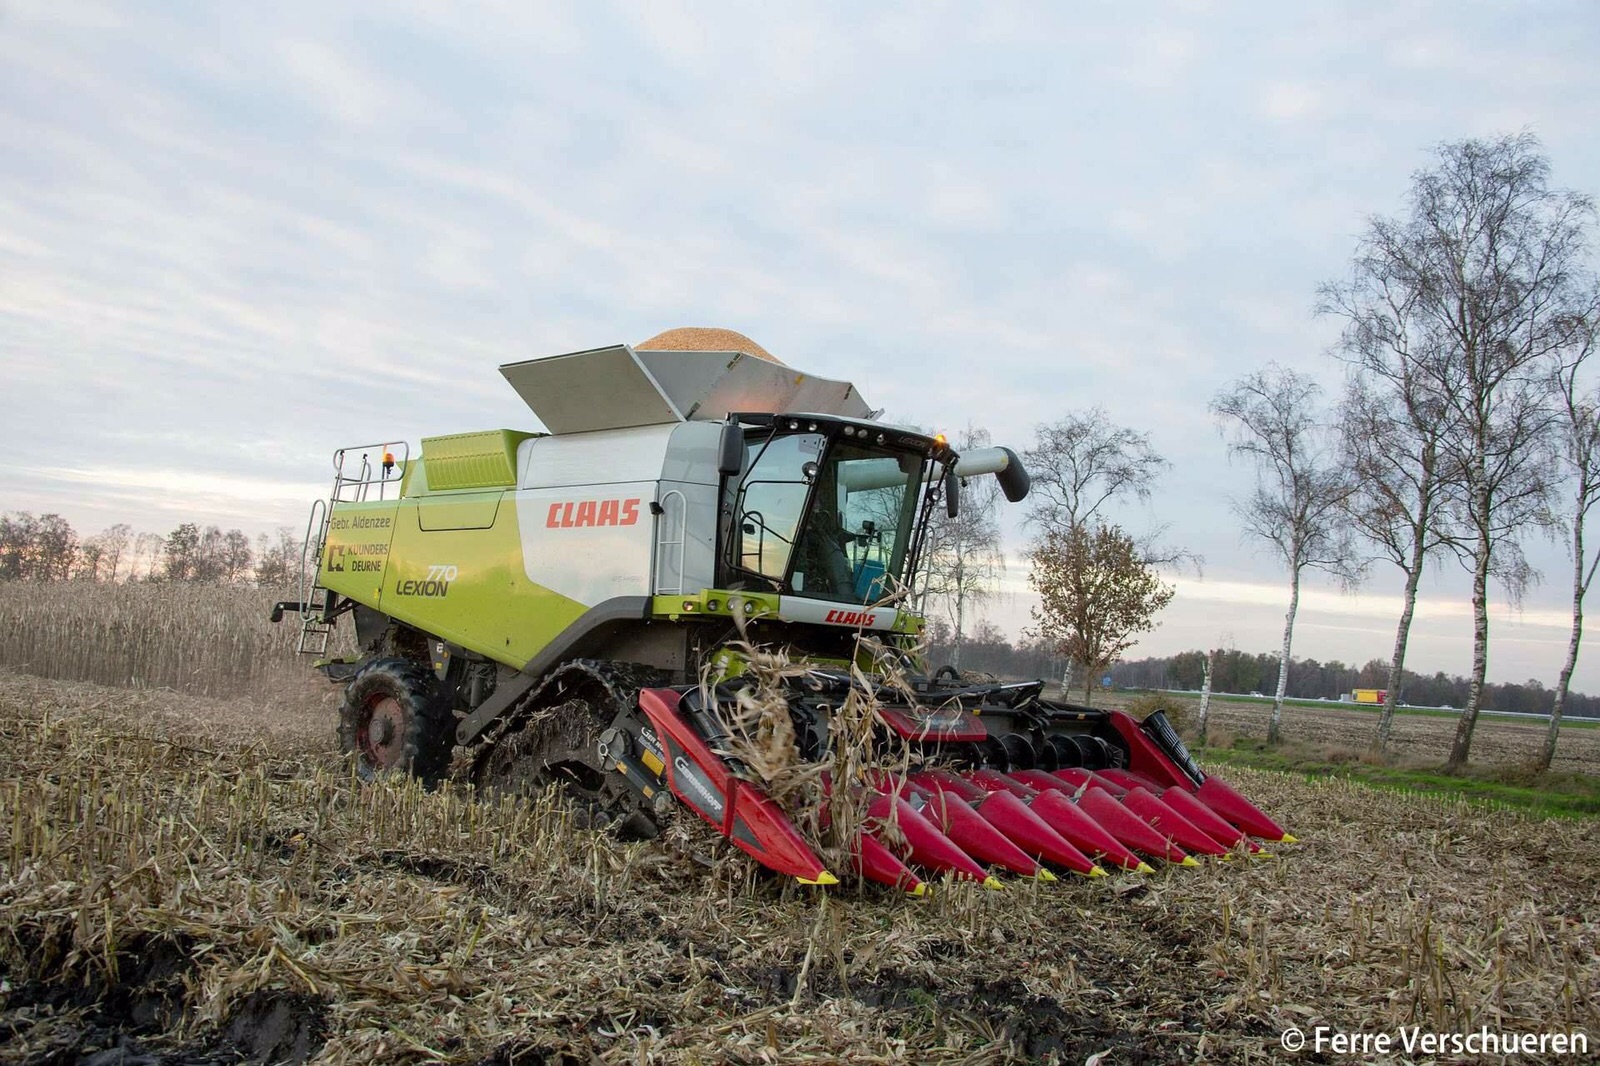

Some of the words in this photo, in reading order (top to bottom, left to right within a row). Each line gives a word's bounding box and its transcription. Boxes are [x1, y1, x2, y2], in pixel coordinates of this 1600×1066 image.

[546, 498, 640, 528] CLAAS
[331, 517, 350, 530] Gebr.
[352, 516, 391, 529] Aldenzee
[352, 560, 382, 572] DEURNE
[426, 565, 457, 582] 770
[396, 580, 449, 597] LEXION
[825, 610, 877, 627] CLAAS
